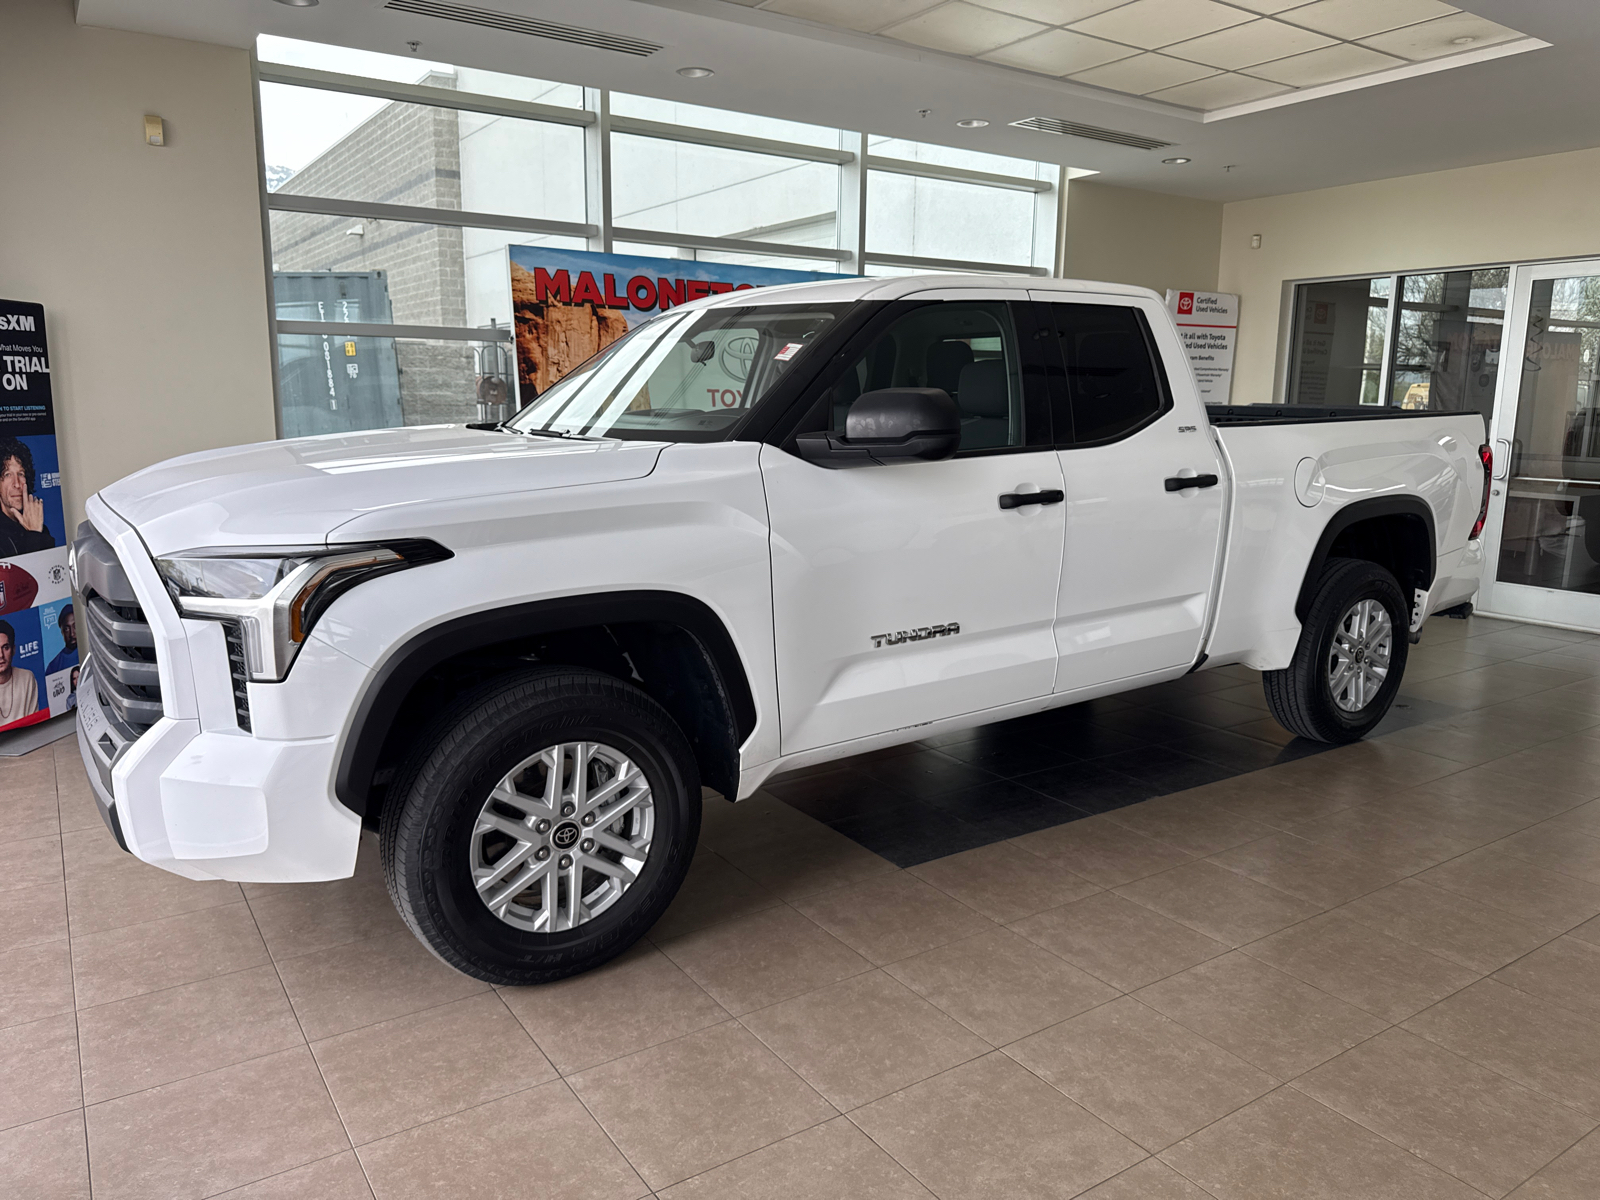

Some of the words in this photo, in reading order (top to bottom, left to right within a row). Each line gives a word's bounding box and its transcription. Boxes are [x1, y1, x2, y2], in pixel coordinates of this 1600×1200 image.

[534, 267, 766, 312] MALONET
[1196, 297, 1218, 305] Certified
[1196, 305, 1209, 313] Used
[1209, 306, 1228, 315] Vehicles
[1184, 332, 1188, 340] it
[1197, 332, 1209, 340] with
[1209, 333, 1226, 342] Toyota
[12, 344, 32, 352] Moves
[32, 345, 43, 353] You
[1193, 341, 1207, 350] Used
[1207, 342, 1228, 351] Vehicles
[3, 355, 50, 373] TRIAL
[2, 373, 28, 391] ON
[1178, 425, 1197, 433] SR5
[871, 622, 960, 648] TUNDRA
[19, 640, 39, 654] LIFE
